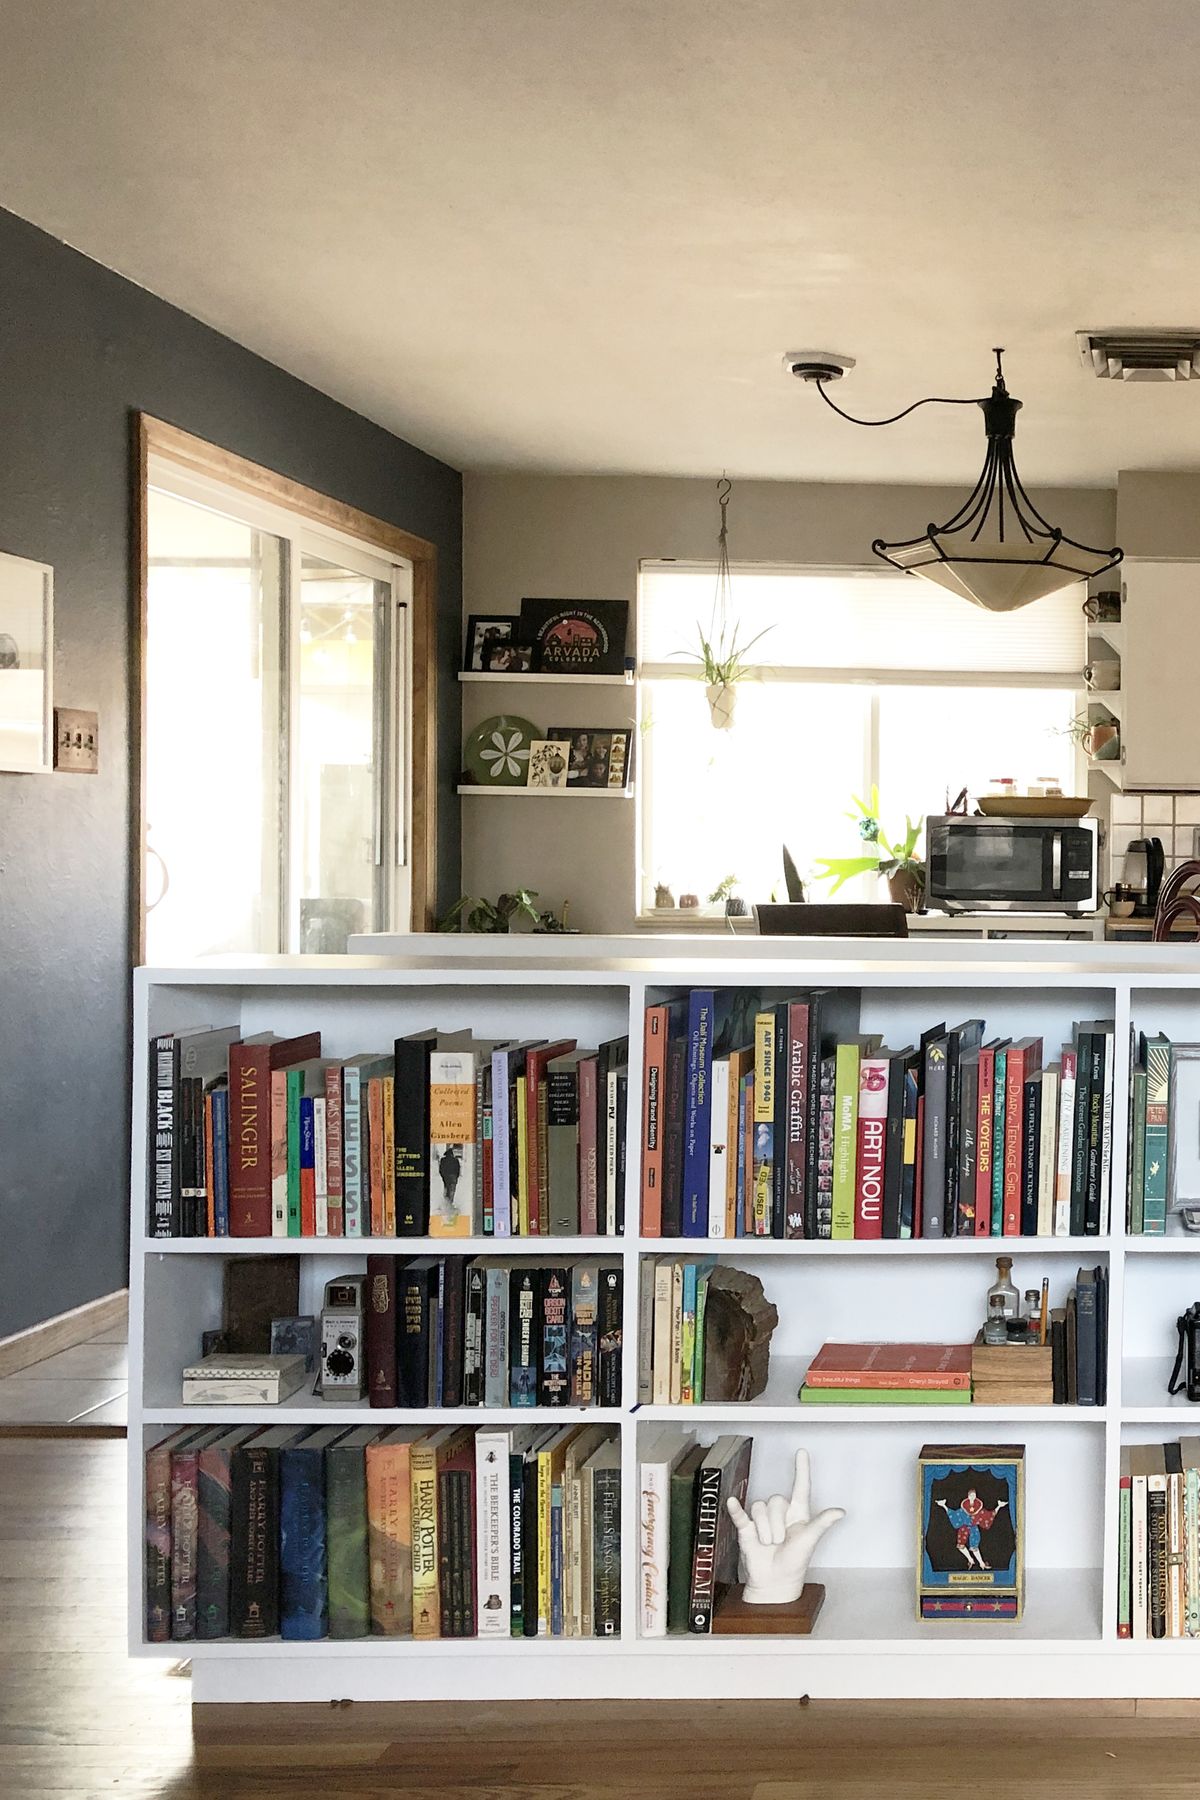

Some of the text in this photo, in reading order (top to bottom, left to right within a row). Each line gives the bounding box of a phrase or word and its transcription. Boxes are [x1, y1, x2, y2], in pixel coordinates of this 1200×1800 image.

[543, 647, 600, 657] ARVADA
[700, 1007, 708, 1021] The
[699, 1038, 707, 1068] Museum
[763, 1030, 772, 1102] ART SINCE 1940
[790, 1039, 804, 1086] Arabic
[1092, 1052, 1100, 1065] John
[649, 1067, 657, 1100] Designing
[689, 1073, 698, 1095] Objects
[698, 1070, 707, 1105] Collection
[1008, 1084, 1020, 1115] DIARY
[1078, 1086, 1086, 1100] The
[157, 1090, 173, 1131] BLACK
[240, 1067, 257, 1170] SALINGER
[327, 1074, 340, 1168] TIME WAS SOFT THERE
[790, 1089, 803, 1143] Graffiti
[810, 1117, 815, 1125] OF
[430, 1131, 470, 1141] Ginsberg
[648, 1122, 657, 1149] Identity
[688, 1139, 696, 1156] Paper
[690, 1129, 696, 1138] on
[839, 1095, 852, 1184] MoMA Highlights
[979, 1093, 990, 1172] THE VOYEURS
[1077, 1122, 1085, 1149] Garden
[1088, 1093, 1101, 1203] Rocky Mountain Gardener's Guide
[1103, 1121, 1111, 1148] CRAFTS
[862, 1121, 883, 1220] ART NOW
[1006, 1122, 1019, 1198] TEENAGE GIRL
[1076, 1150, 1084, 1193] Greenhouse
[756, 1192, 764, 1215] USED
[490, 1296, 498, 1327] SPEAKER
[489, 1329, 498, 1343] FOR
[521, 1319, 530, 1344] ENDER'S
[489, 1344, 498, 1359] THE
[583, 1350, 593, 1401] ENDER
[927, 1378, 949, 1386] Strayed
[413, 1507, 421, 1542] CURSED
[420, 1480, 436, 1576] HARRY POTTER
[490, 1473, 499, 1581] THE BEEKEEPER'S BIBLE
[513, 1488, 521, 1574] THE COLORADO TRAIL
[603, 1491, 615, 1574] FIFTH SEASON
[694, 1470, 720, 1596] NIGHT FILM
[1158, 1513, 1166, 1544] TONI
[642, 1491, 660, 1612] Emergency Contact
